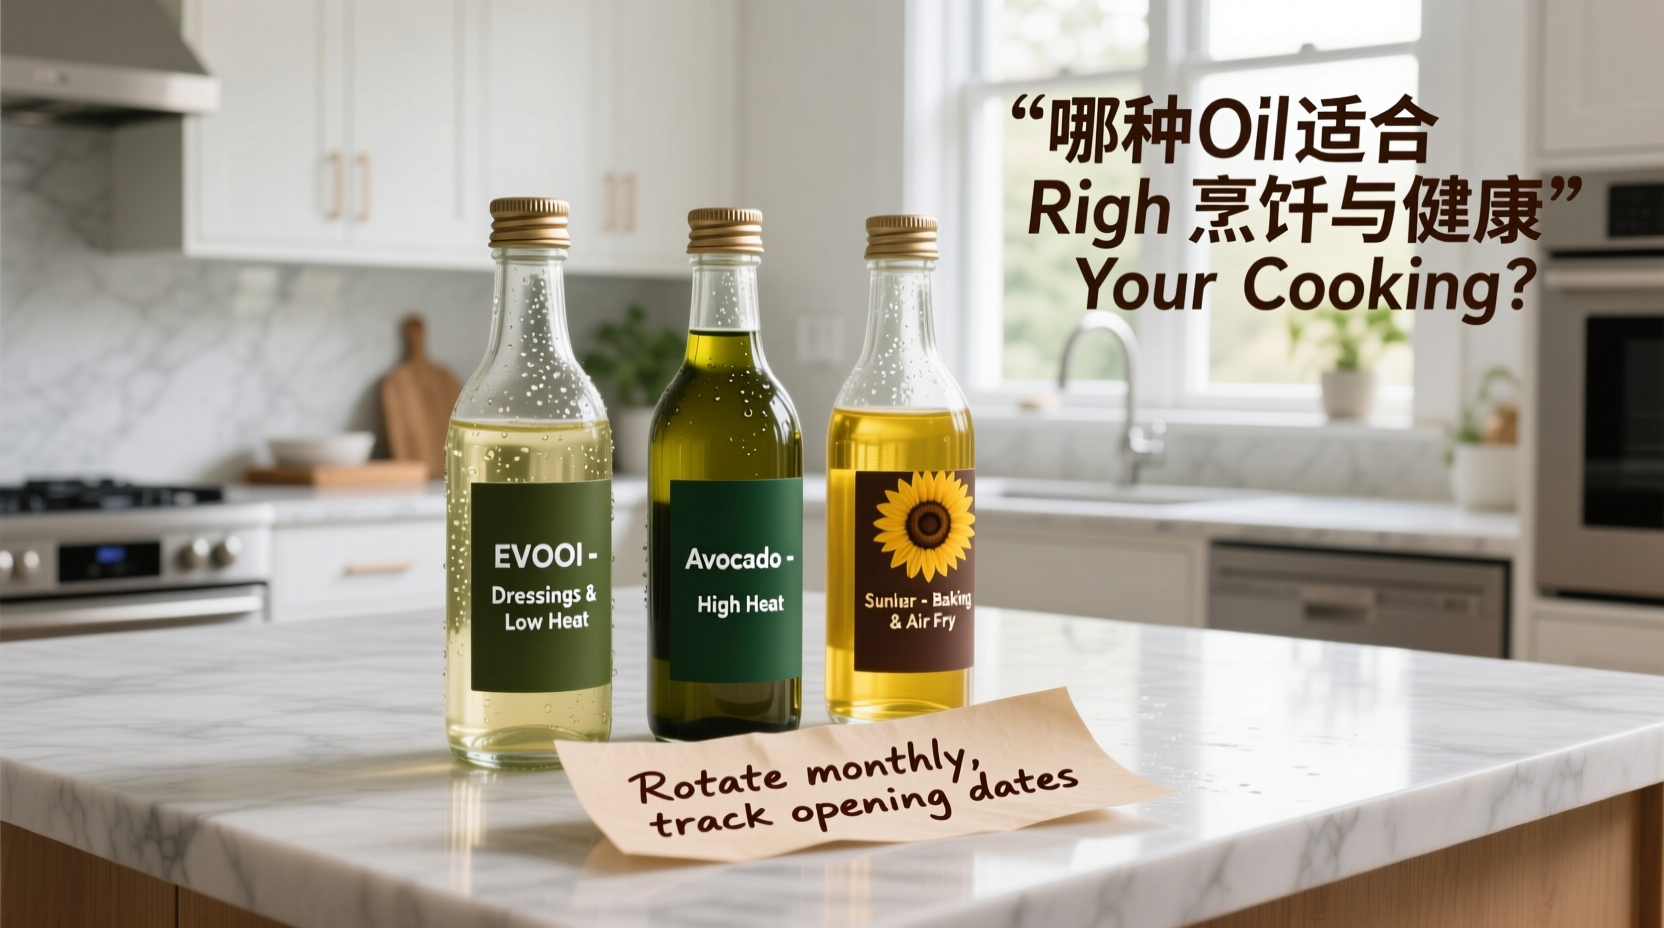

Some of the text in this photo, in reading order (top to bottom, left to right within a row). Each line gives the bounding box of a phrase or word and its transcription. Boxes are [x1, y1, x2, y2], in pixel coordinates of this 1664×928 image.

[684, 545, 782, 571] Avocado
[492, 583, 597, 609] Dressings &
[697, 594, 785, 619] High Heat
[505, 610, 590, 631] Low Heat
[889, 611, 957, 632] & Air Fry
[627, 737, 981, 805] Rotate monthly,
[649, 766, 1079, 838] track opening dates
